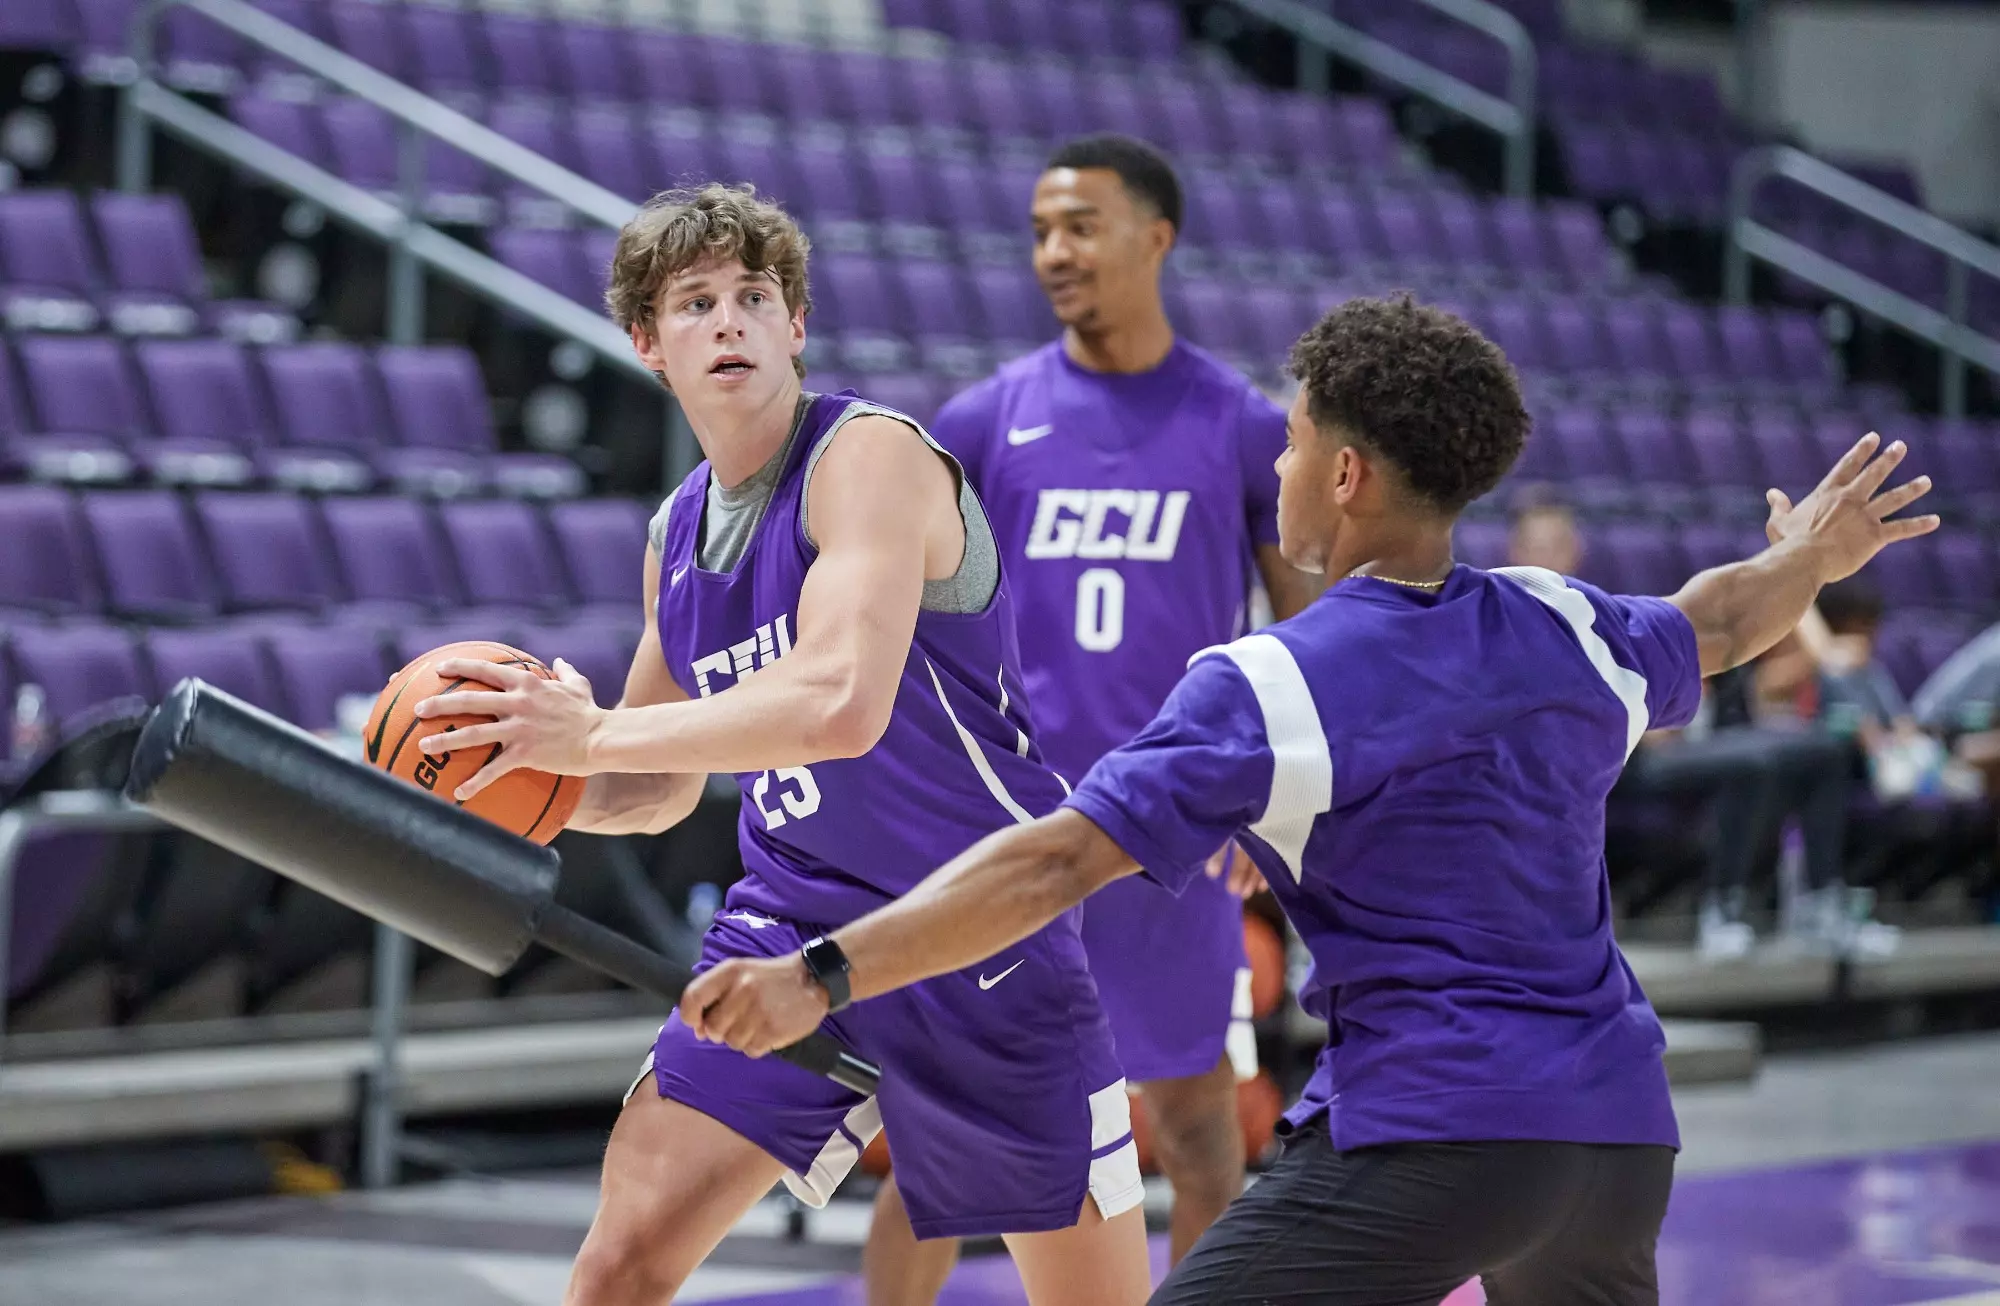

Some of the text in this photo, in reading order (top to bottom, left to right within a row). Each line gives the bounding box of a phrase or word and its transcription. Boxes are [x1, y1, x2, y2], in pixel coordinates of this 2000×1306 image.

[1024, 488, 1191, 562] GCU
[1074, 567, 1125, 652] 0
[414, 724, 457, 791] GC
[753, 766, 821, 831] 25
